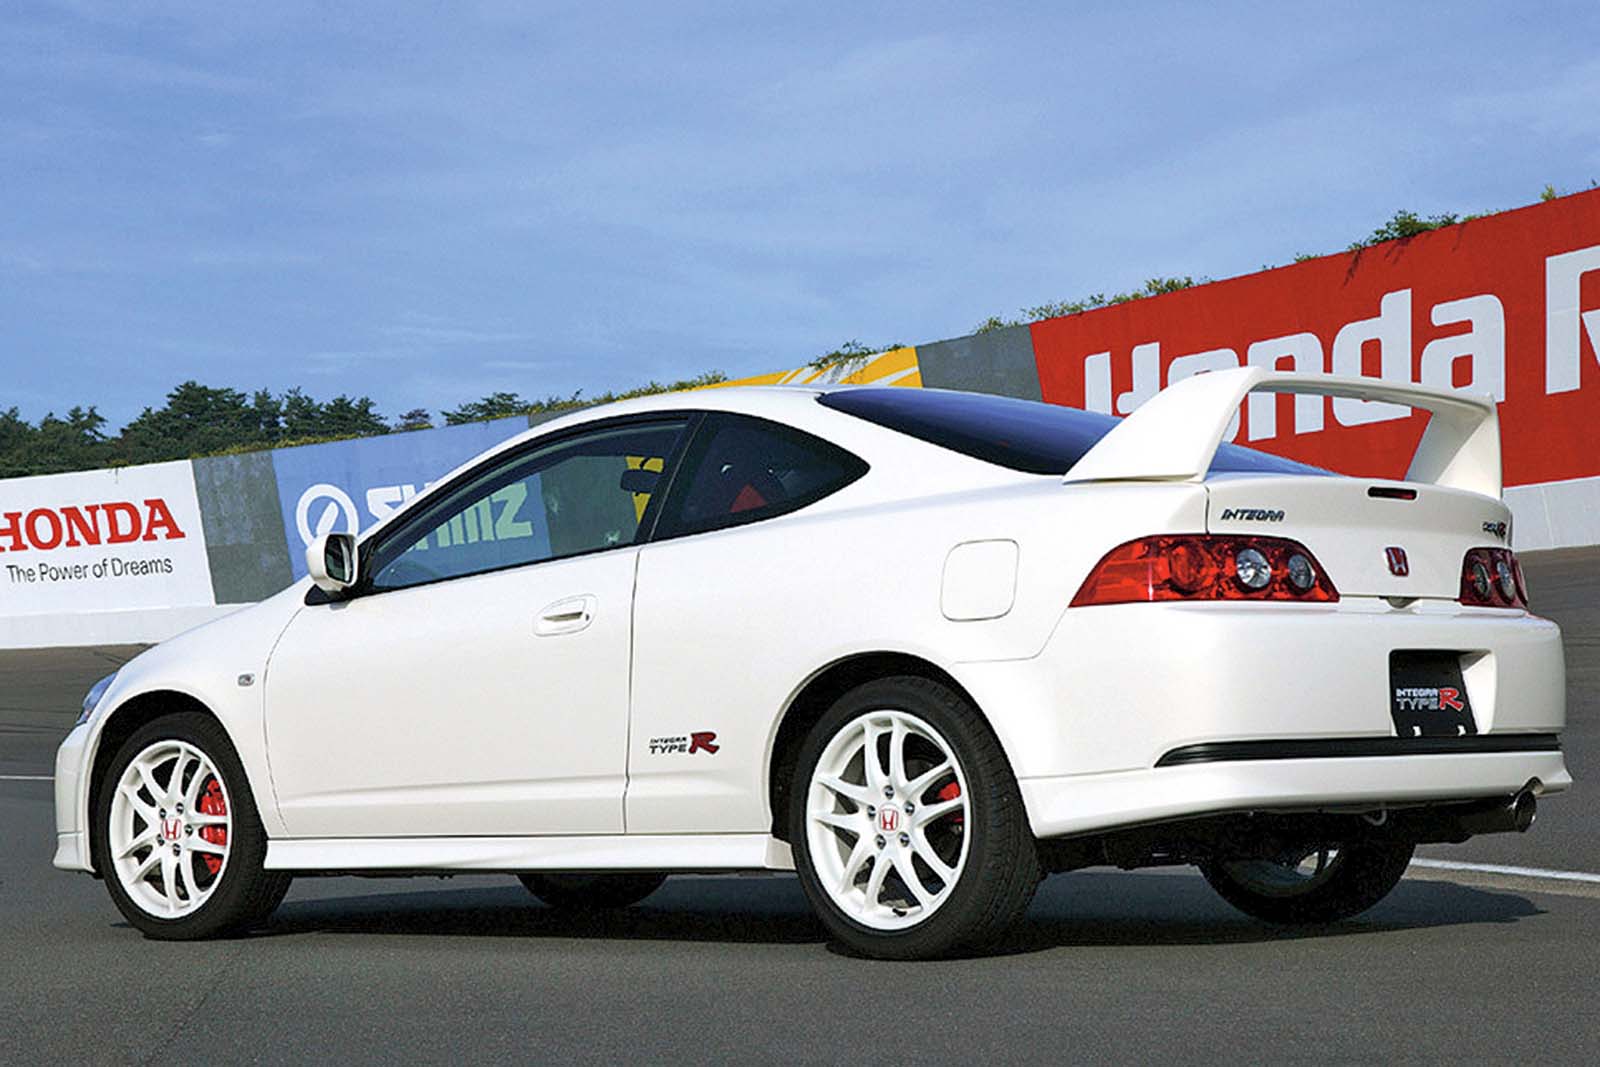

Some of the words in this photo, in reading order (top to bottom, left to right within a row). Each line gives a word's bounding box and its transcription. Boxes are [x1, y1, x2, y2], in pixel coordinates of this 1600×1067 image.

[1221, 508, 1285, 522] INTEGRA
[0, 498, 186, 553] HONDA
[6, 564, 36, 583] The
[38, 562, 88, 582] Power
[92, 558, 109, 579] of
[111, 557, 174, 577] Dreams
[1396, 687, 1438, 697] INTEGRA
[1396, 698, 1438, 710] TYPE
[649, 744, 687, 754] TYPE
[688, 731, 720, 754] R
